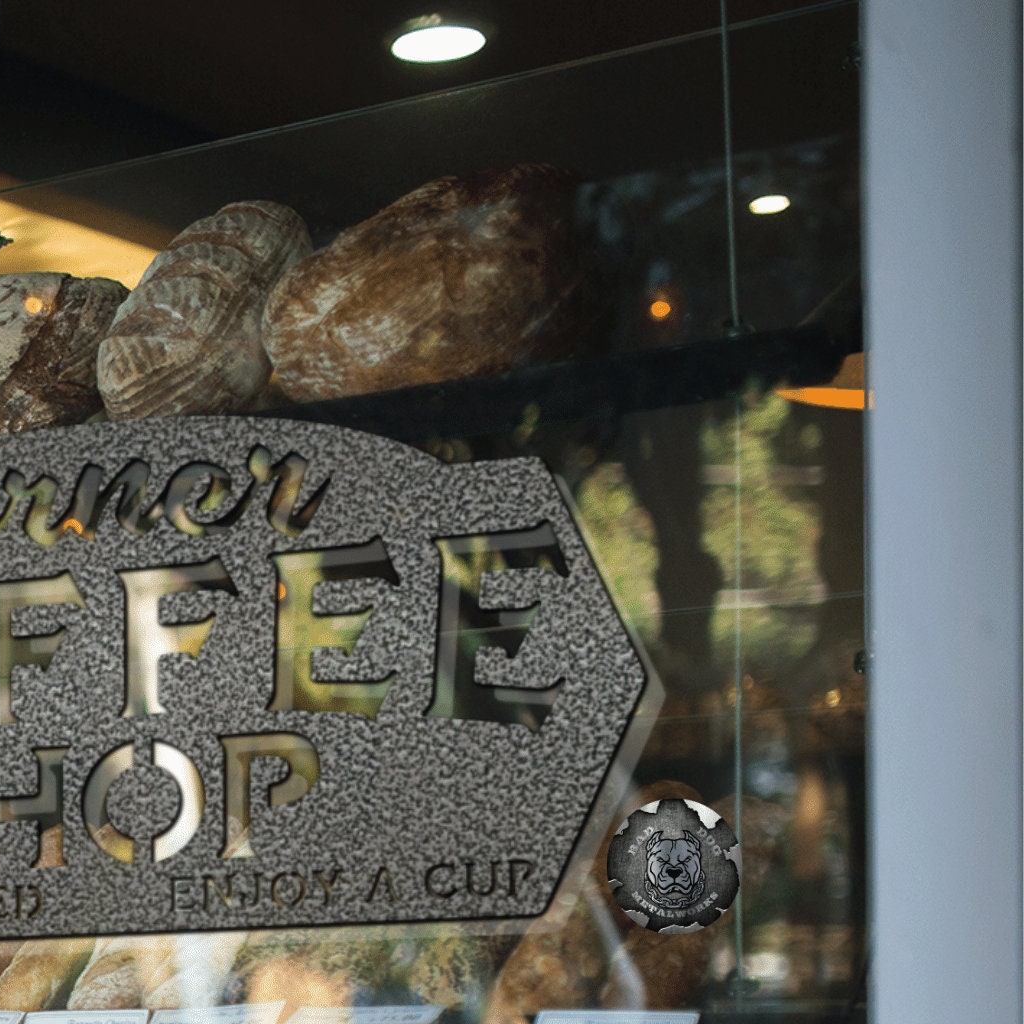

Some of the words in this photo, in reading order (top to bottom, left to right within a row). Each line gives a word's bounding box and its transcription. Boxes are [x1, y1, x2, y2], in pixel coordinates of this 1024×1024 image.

[169, 867, 342, 914] ENJOY
[366, 864, 398, 904] A
[425, 858, 533, 901] CUP
